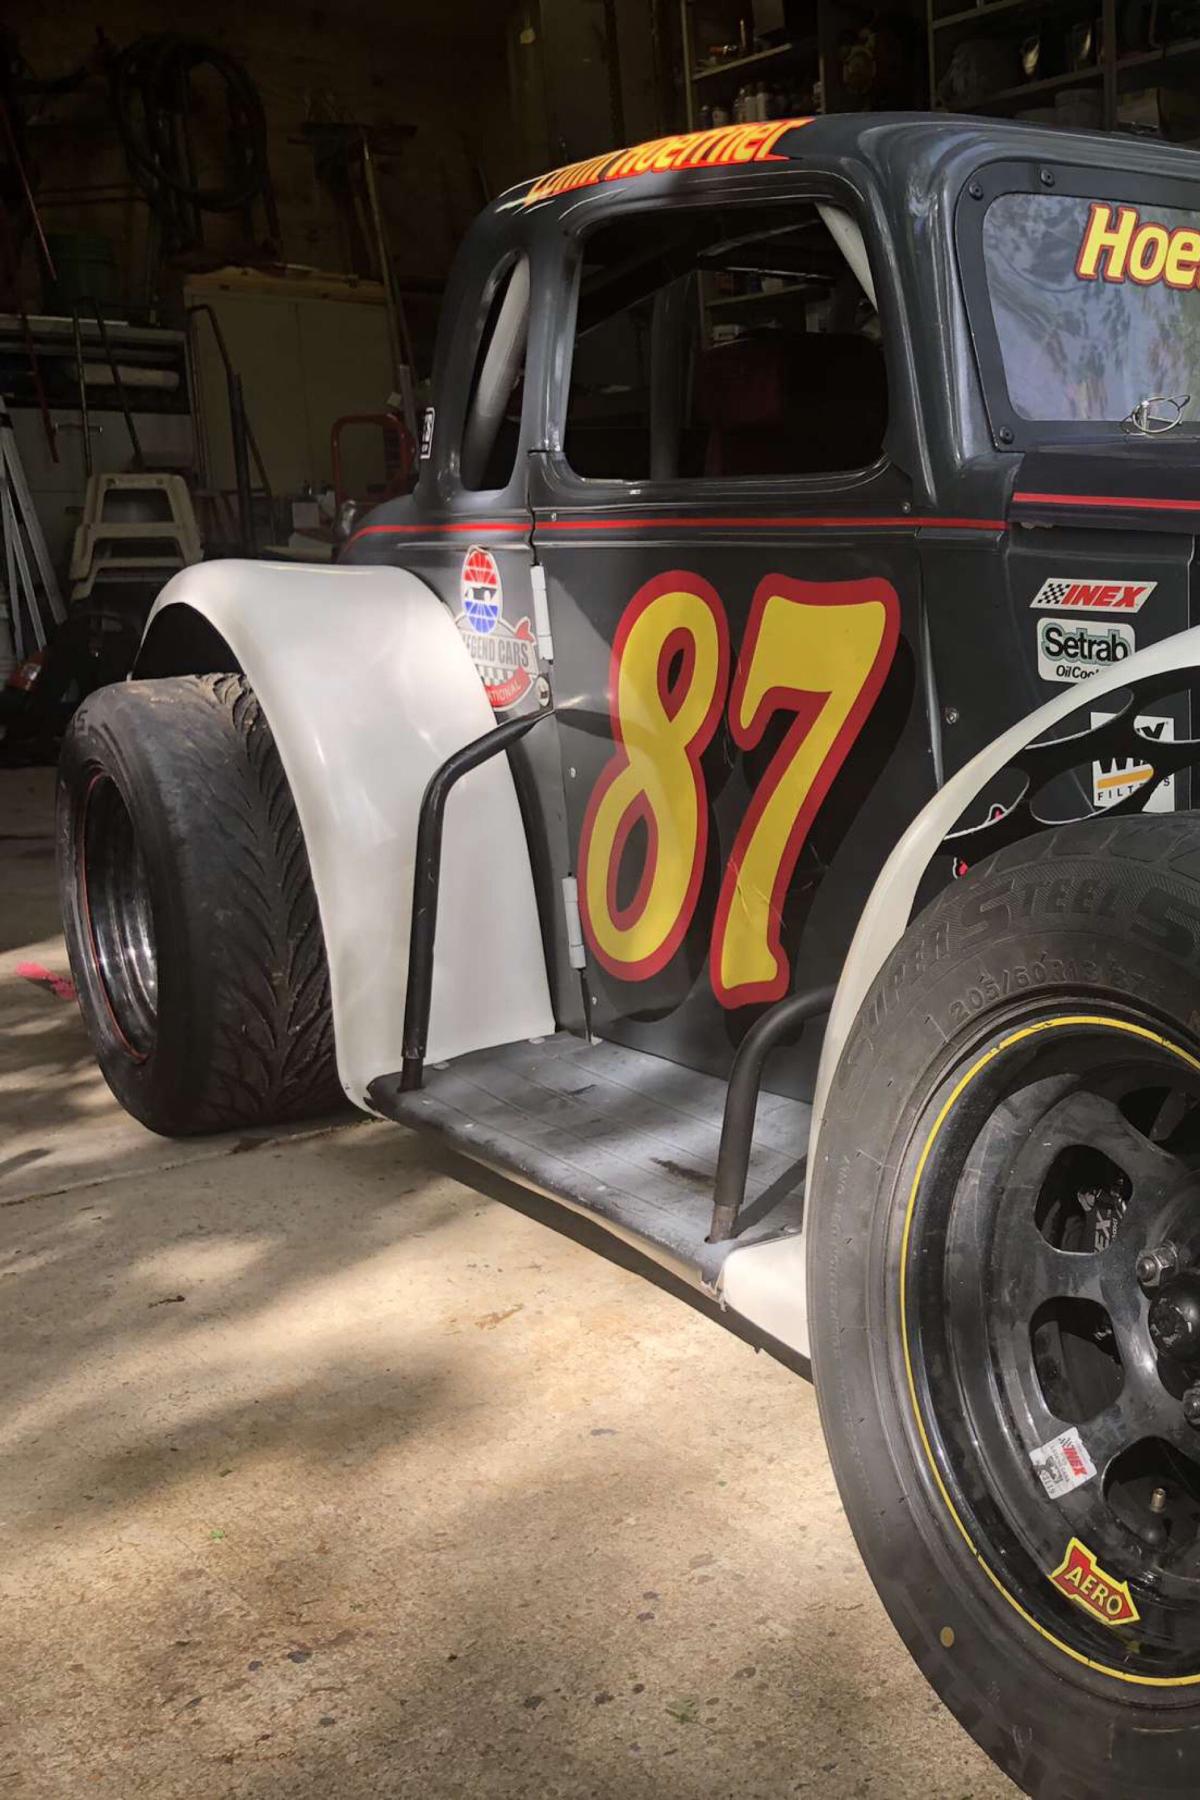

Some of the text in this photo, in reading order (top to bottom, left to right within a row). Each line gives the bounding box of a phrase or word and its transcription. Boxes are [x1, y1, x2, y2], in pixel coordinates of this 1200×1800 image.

[1061, 584, 1147, 608] INEX
[497, 638, 529, 667] CARS
[1044, 625, 1130, 663] Setrab
[578, 569, 900, 1010] 87
[1097, 776, 1171, 802] FILTS
[1065, 1566, 1123, 1615] AERO
